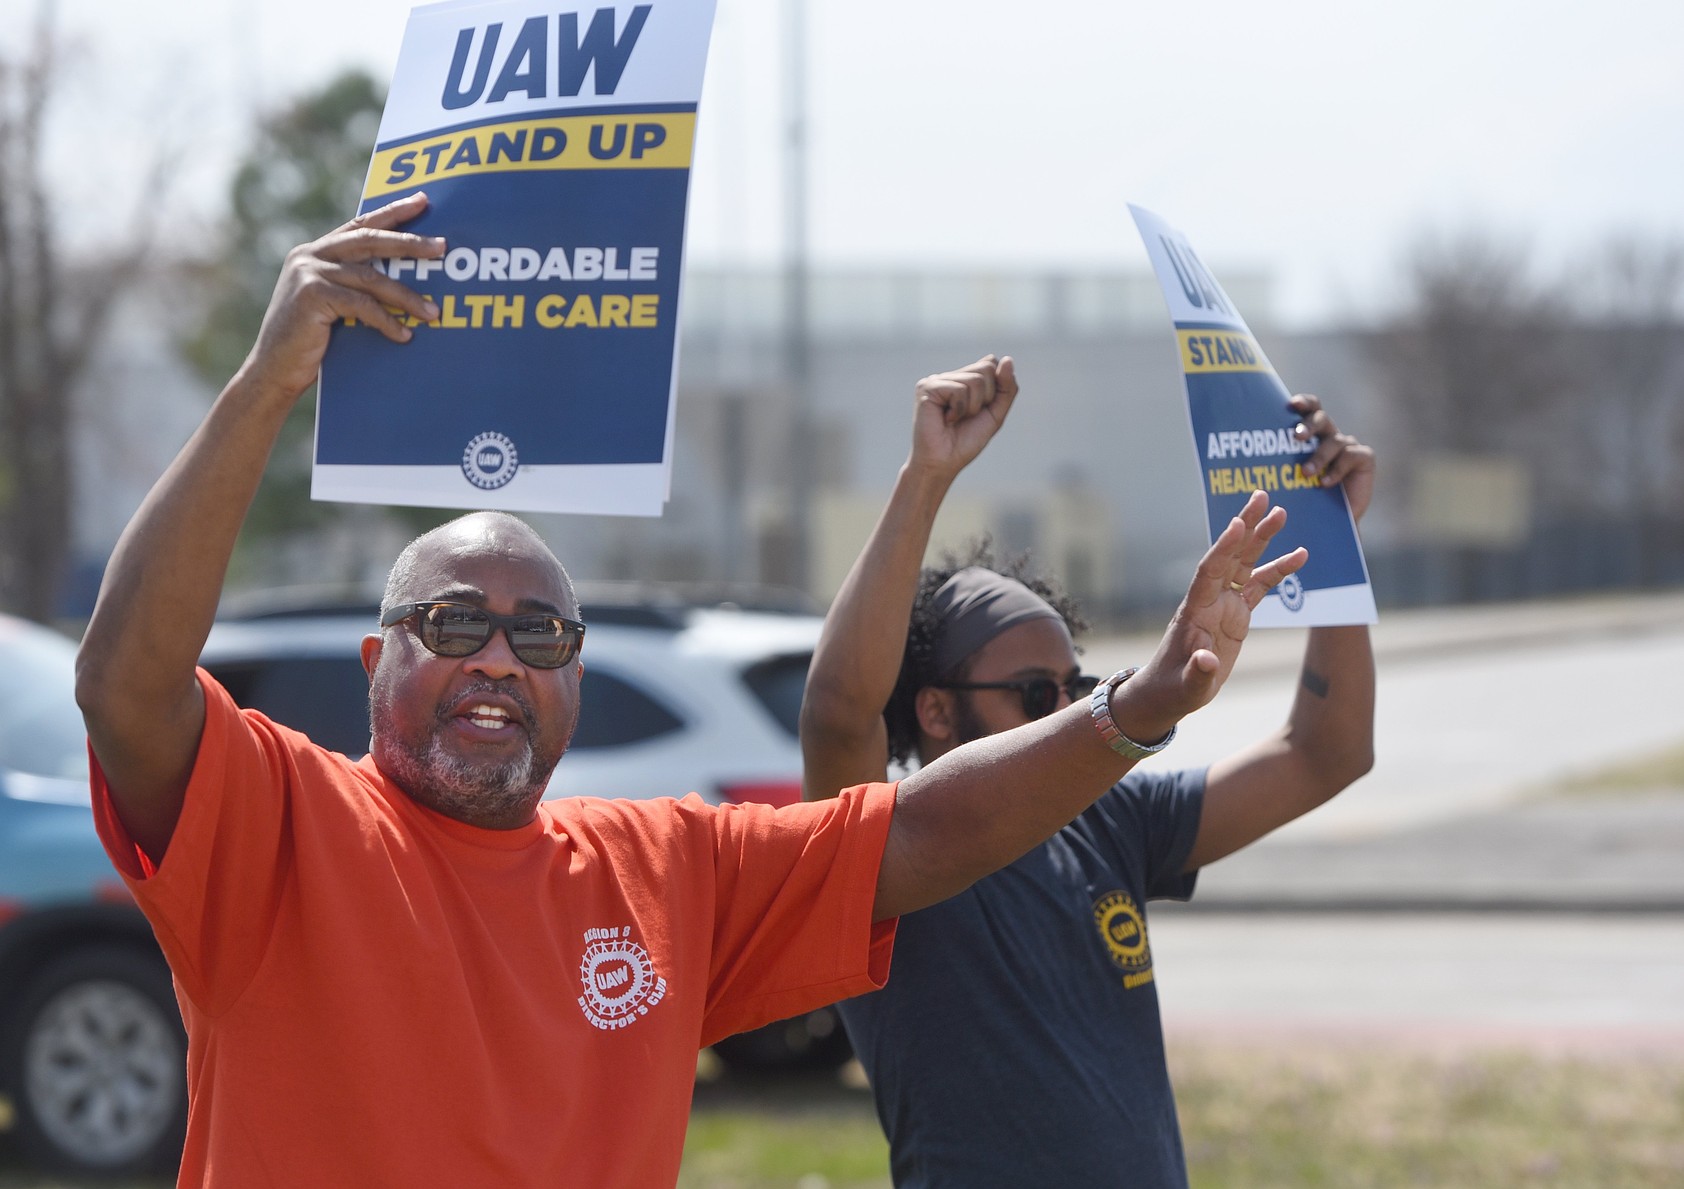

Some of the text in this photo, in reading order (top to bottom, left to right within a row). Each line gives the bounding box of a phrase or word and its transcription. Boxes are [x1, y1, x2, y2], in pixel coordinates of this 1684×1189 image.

[441, 4, 653, 111] UAW
[385, 123, 667, 185] STAND UP
[1158, 233, 1234, 316] UA
[535, 294, 659, 329] CARE
[1209, 463, 1325, 495] HEALTH CAR
[622, 925, 631, 937] 8
[596, 965, 628, 990] UAW
[577, 996, 648, 1030] DIRECTOR'S
